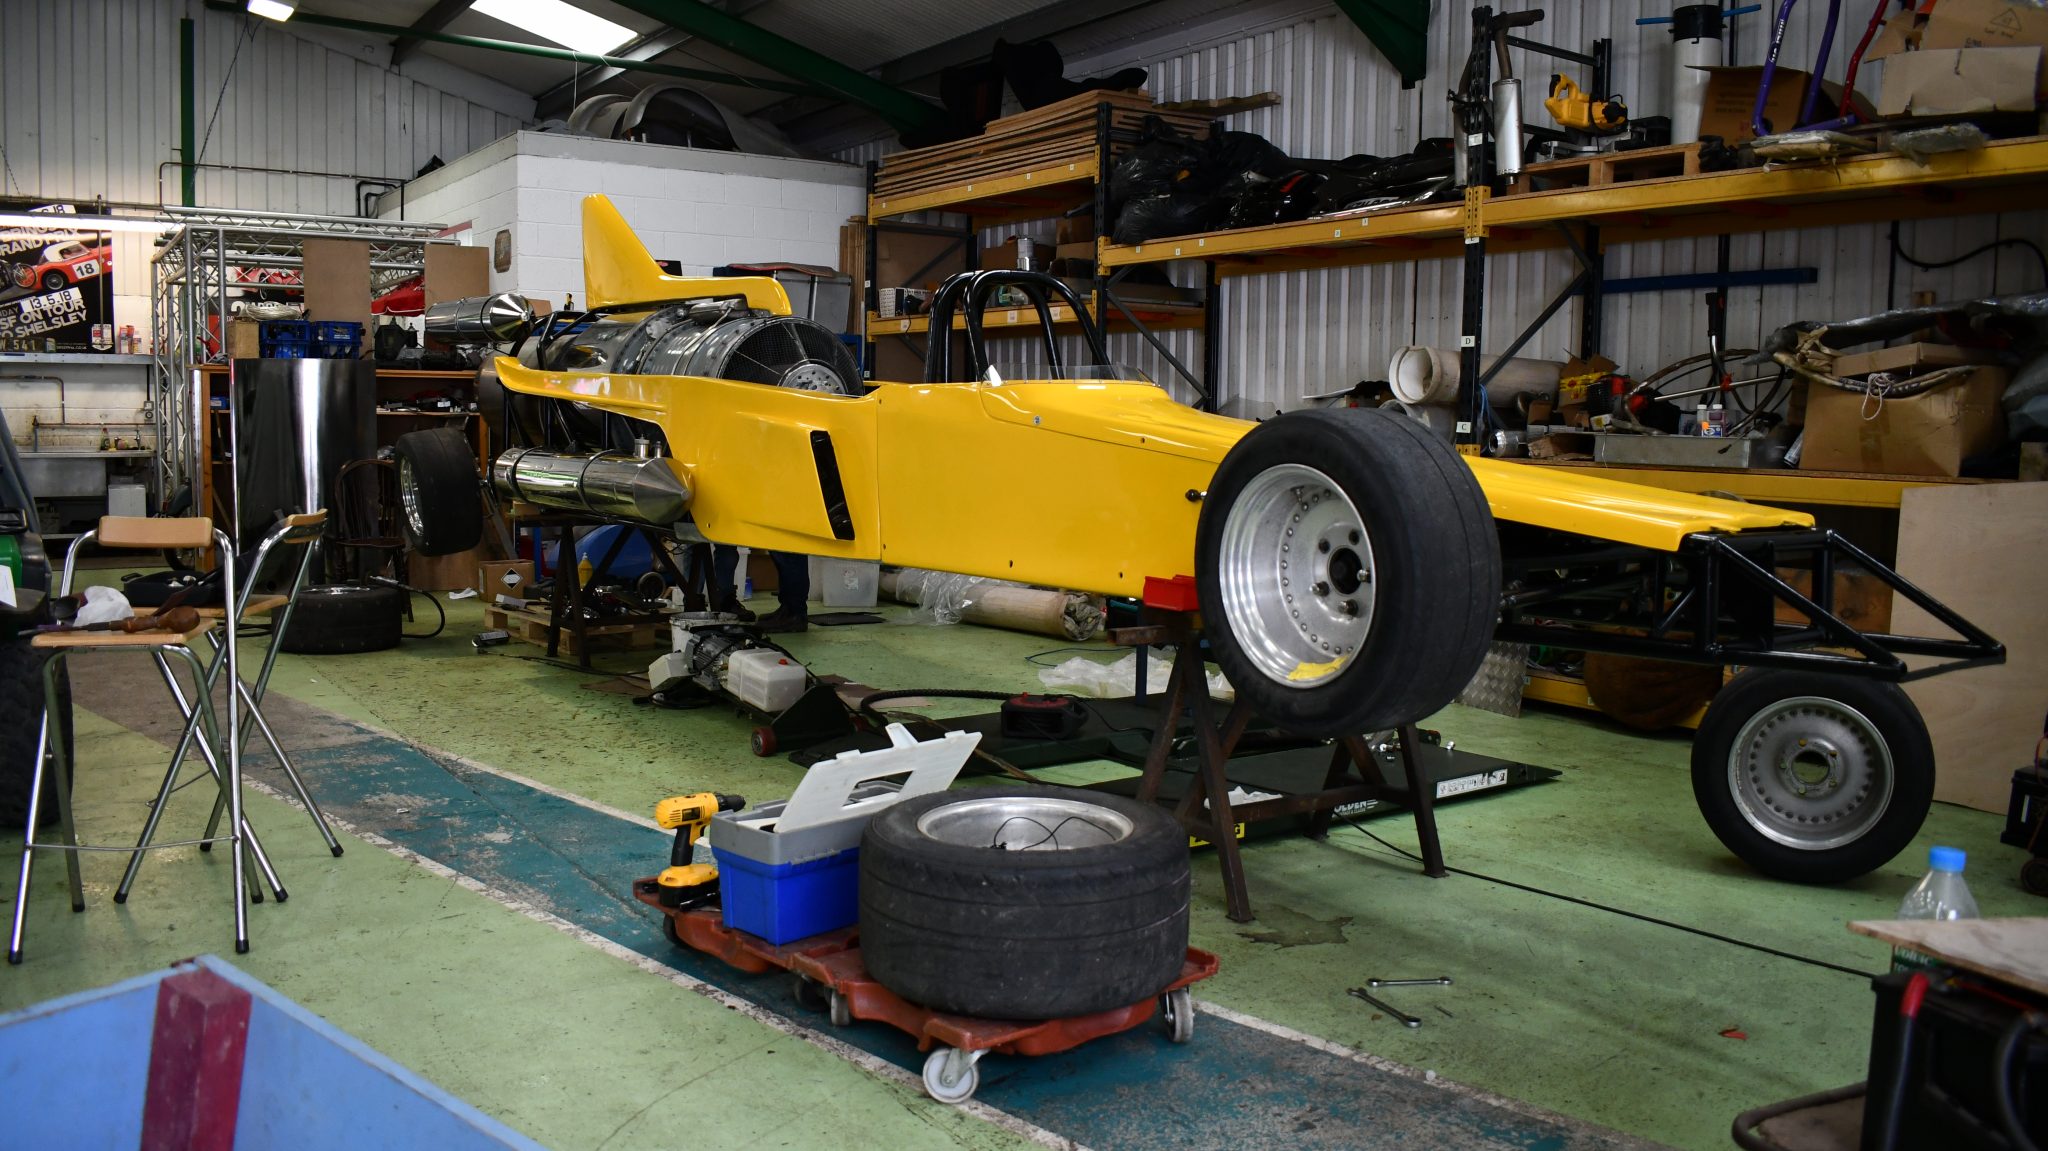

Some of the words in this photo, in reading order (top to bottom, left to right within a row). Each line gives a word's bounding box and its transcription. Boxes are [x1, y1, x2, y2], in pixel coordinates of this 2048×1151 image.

[76, 263, 95, 277] 18
[29, 290, 72, 310] 13.5.18
[20, 310, 43, 324] ON
[44, 299, 86, 318] TOUR
[15, 309, 88, 338] SHELSLEY
